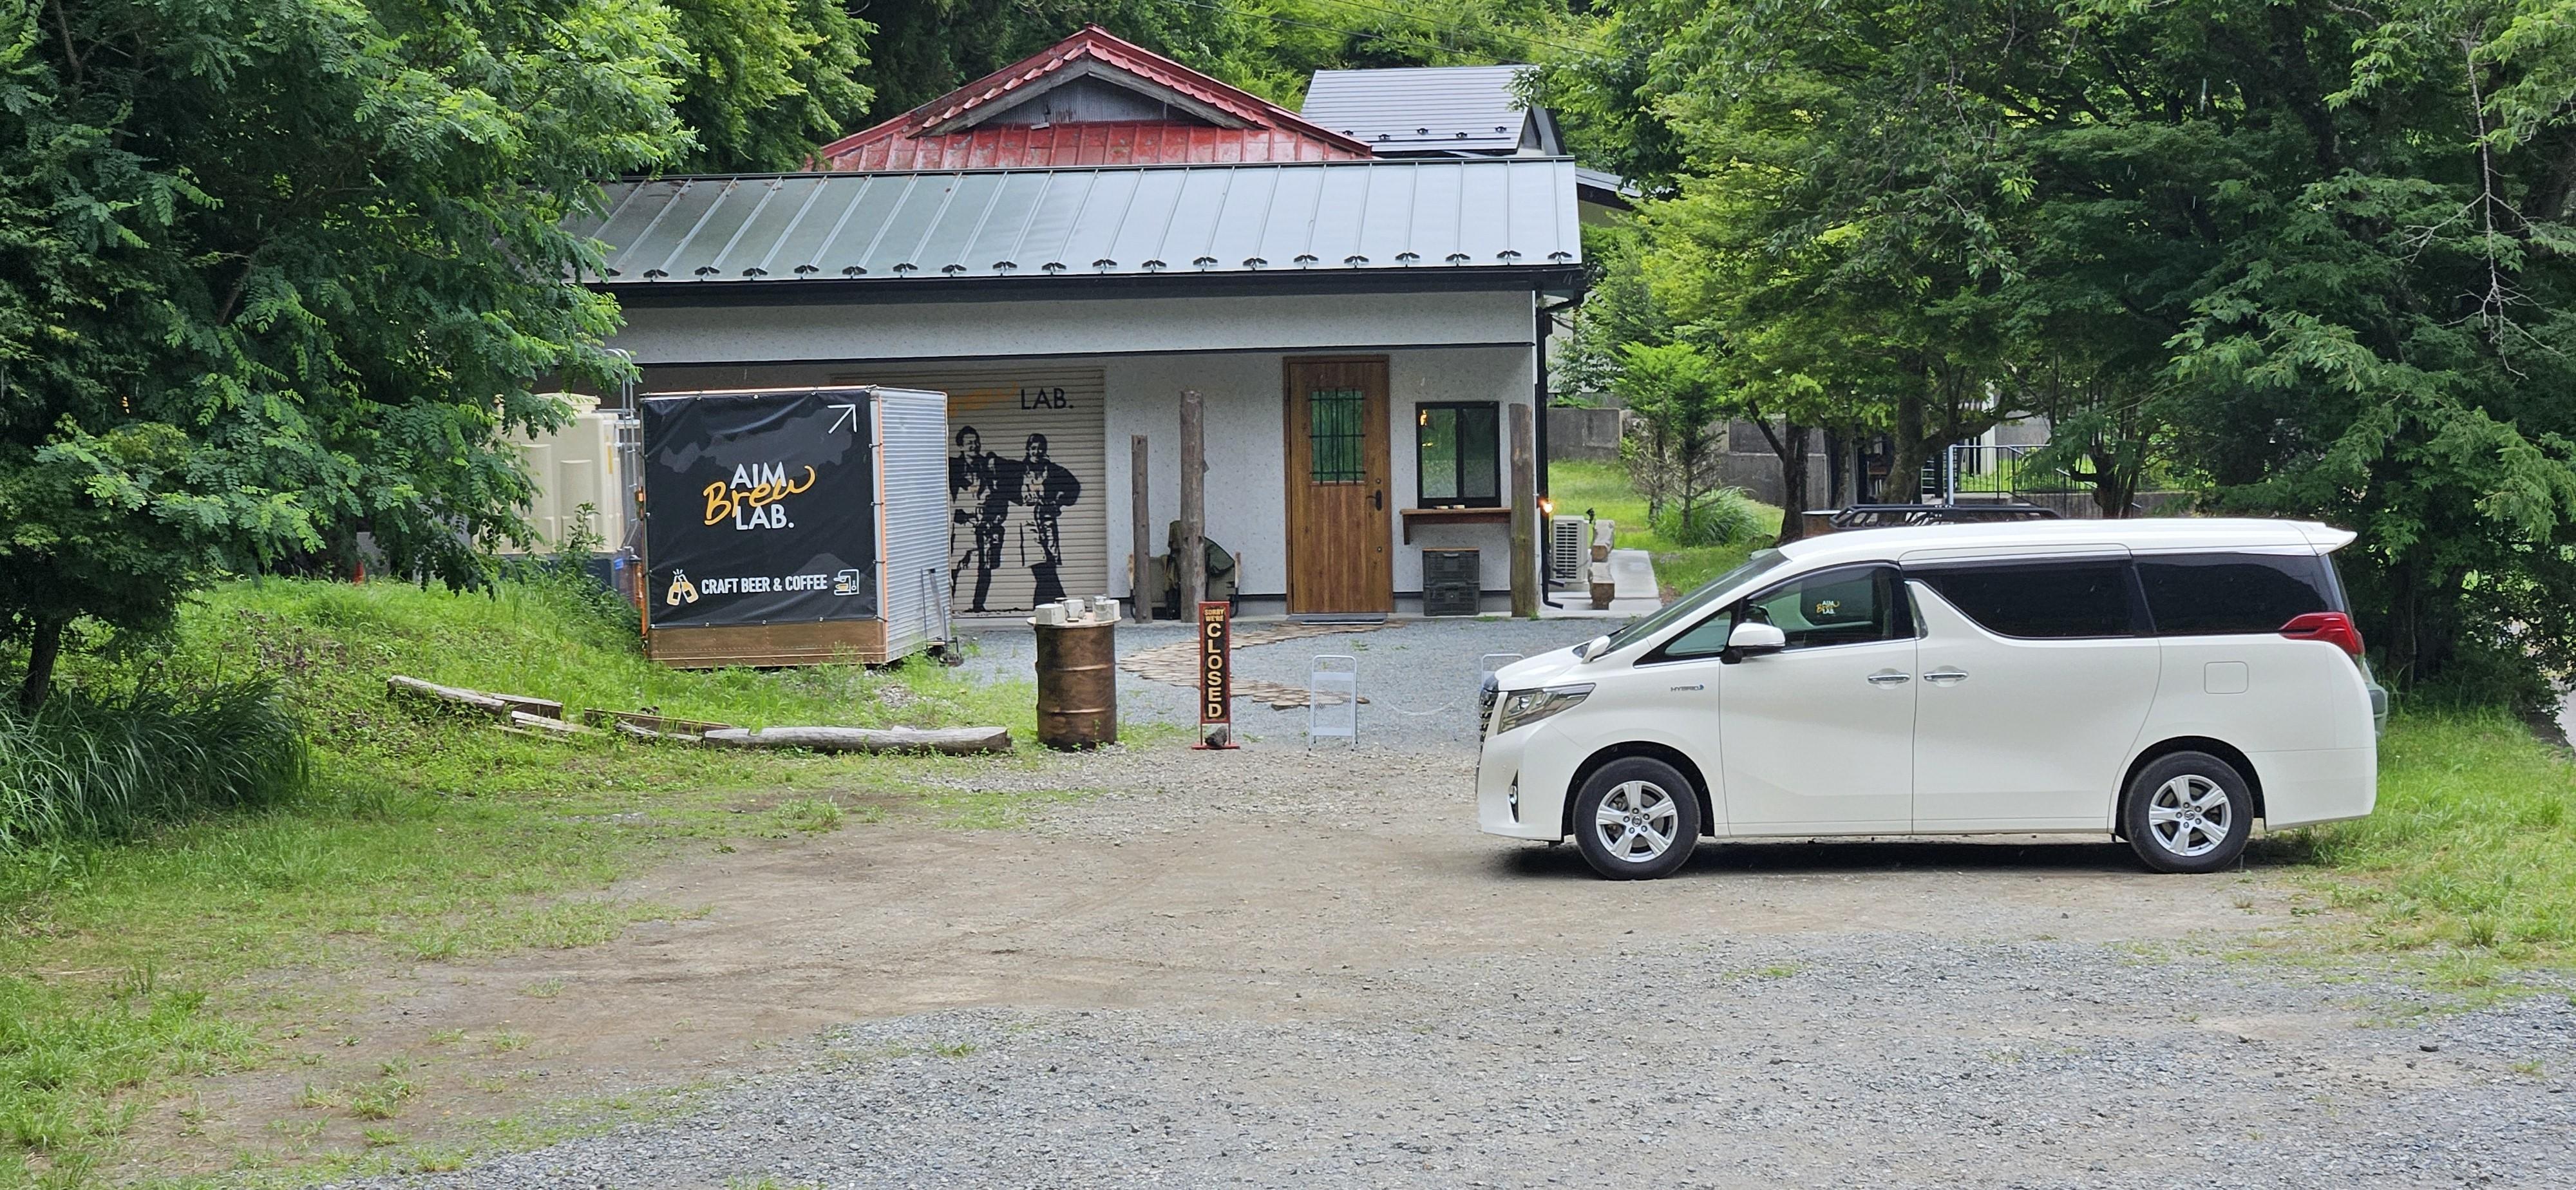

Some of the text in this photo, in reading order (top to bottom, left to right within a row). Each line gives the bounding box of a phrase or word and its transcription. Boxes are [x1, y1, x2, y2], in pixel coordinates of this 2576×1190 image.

[1021, 388, 1074, 410] LAB.
[730, 462, 787, 489] AIM
[703, 465, 816, 525] Brew
[735, 504, 794, 530] LAB.
[701, 574, 828, 594] CRAFT BEER & COFFEE
[1207, 623, 1222, 718] CLOSED
